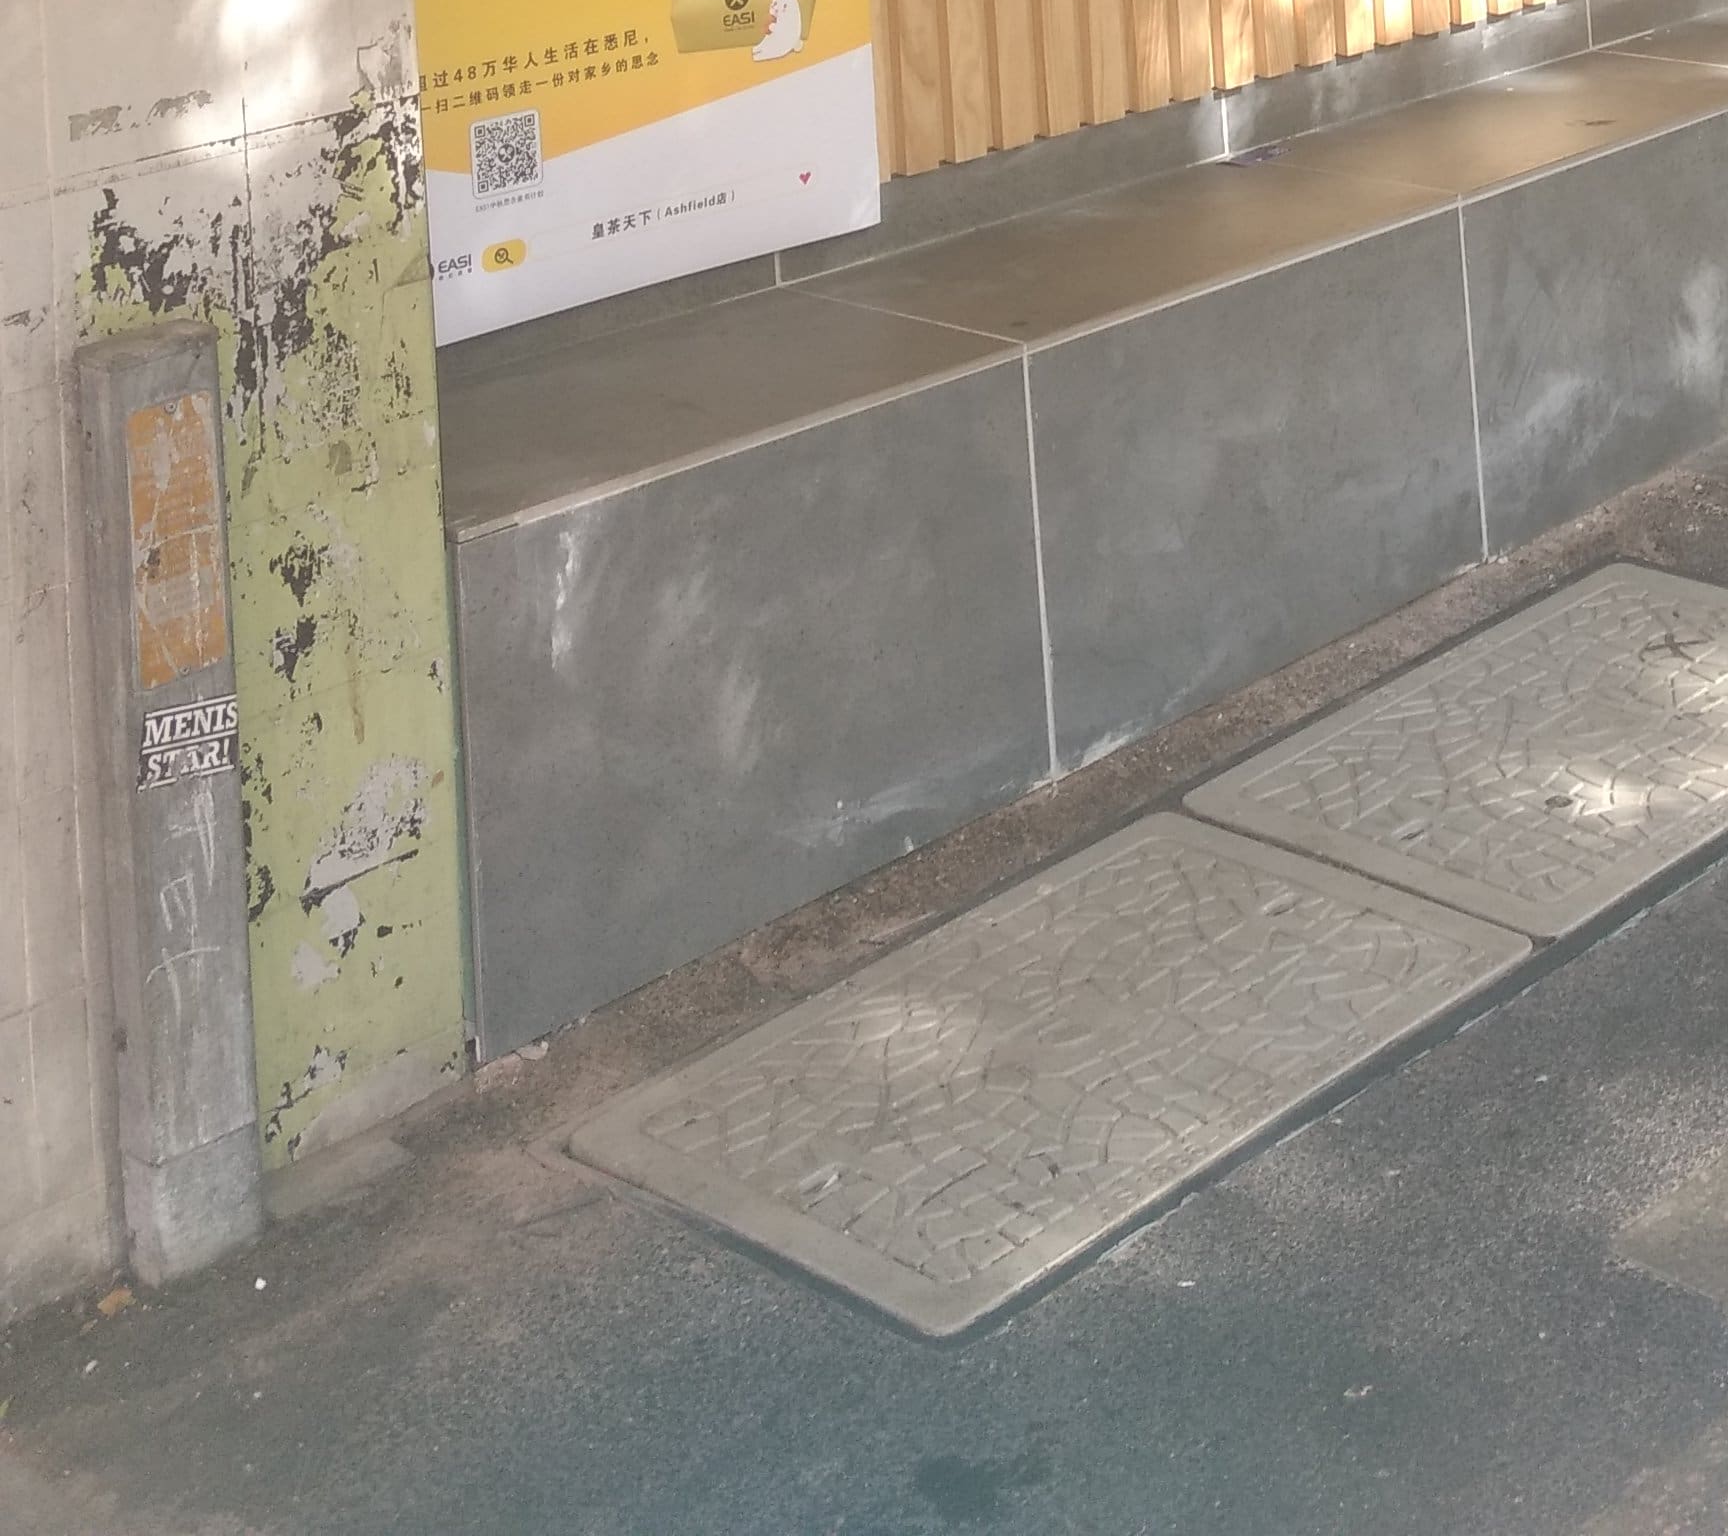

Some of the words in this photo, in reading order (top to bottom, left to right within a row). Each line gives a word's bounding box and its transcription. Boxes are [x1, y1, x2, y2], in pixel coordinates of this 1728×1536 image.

[722, 11, 755, 27] EASI
[438, 253, 472, 274] EASI
[142, 701, 238, 748] MENIS
